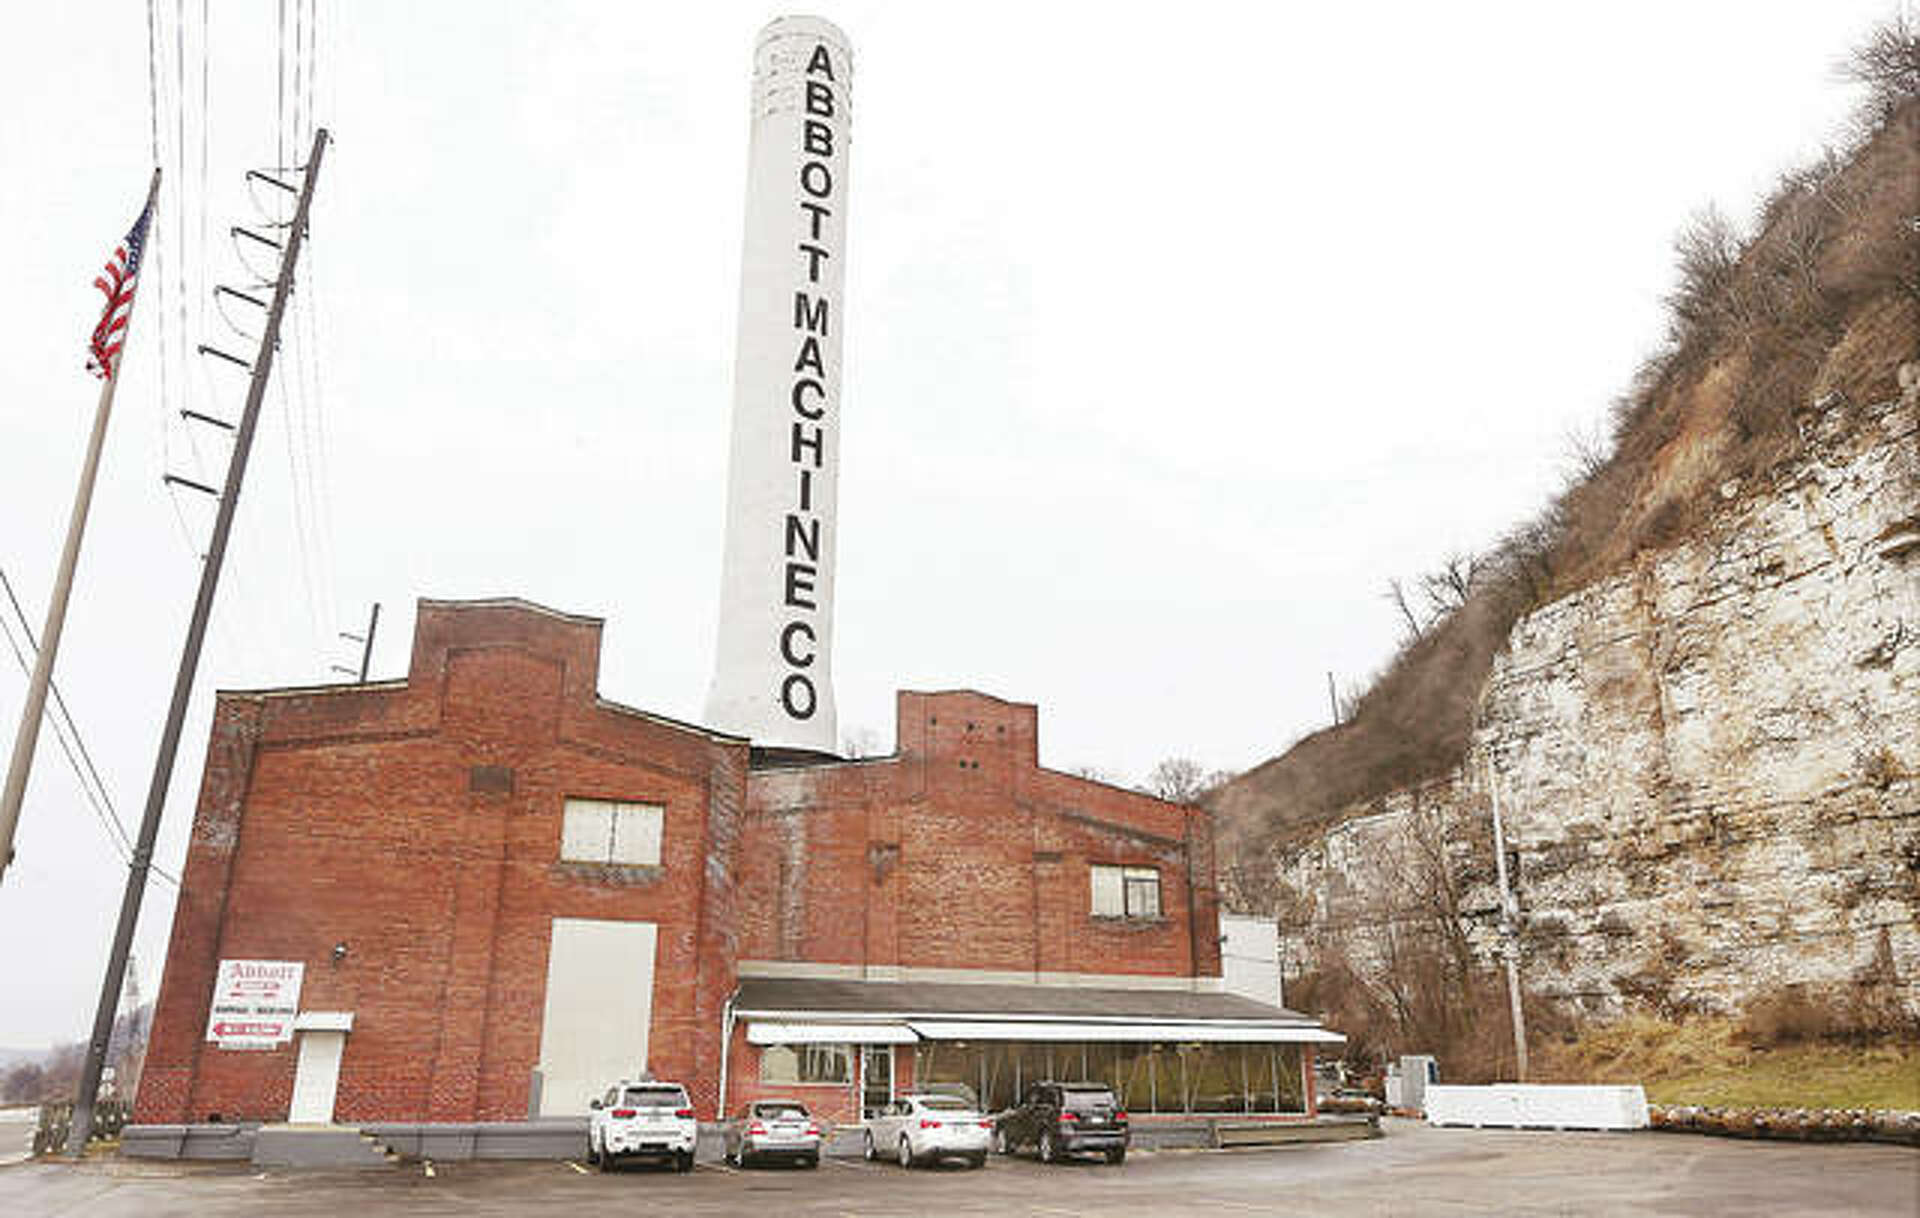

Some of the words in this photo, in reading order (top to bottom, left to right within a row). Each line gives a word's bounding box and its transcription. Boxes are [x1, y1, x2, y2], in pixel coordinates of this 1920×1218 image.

[799, 44, 835, 283] ABBOTT
[785, 291, 829, 611] MACHINE
[780, 620, 817, 720] CO
